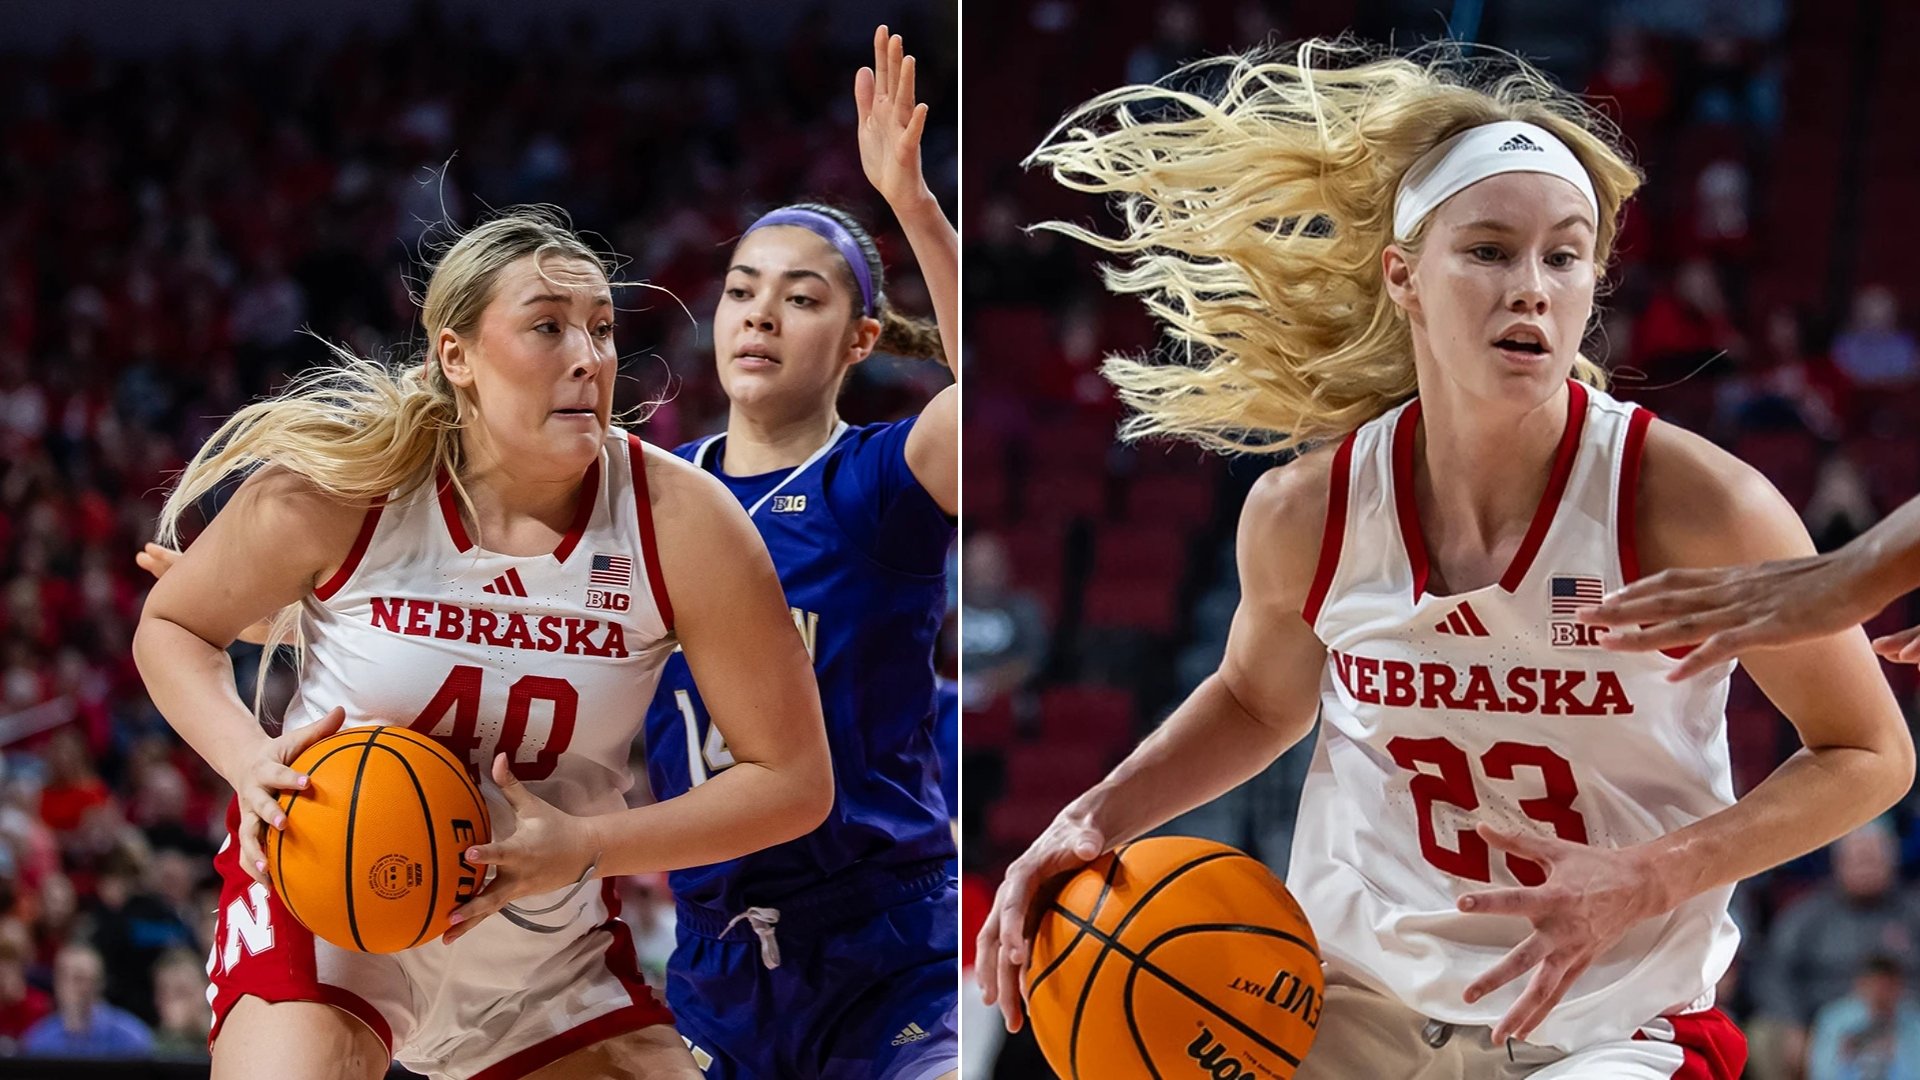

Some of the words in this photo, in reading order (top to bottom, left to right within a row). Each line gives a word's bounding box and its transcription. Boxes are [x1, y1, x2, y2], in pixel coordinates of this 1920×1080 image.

[370, 596, 629, 658] NEBRASKA
[1332, 649, 1635, 715] NEBRASKA
[407, 665, 579, 784] 40
[1385, 736, 1589, 888] 23
[224, 881, 275, 976] N
[1226, 976, 1266, 998] NXT
